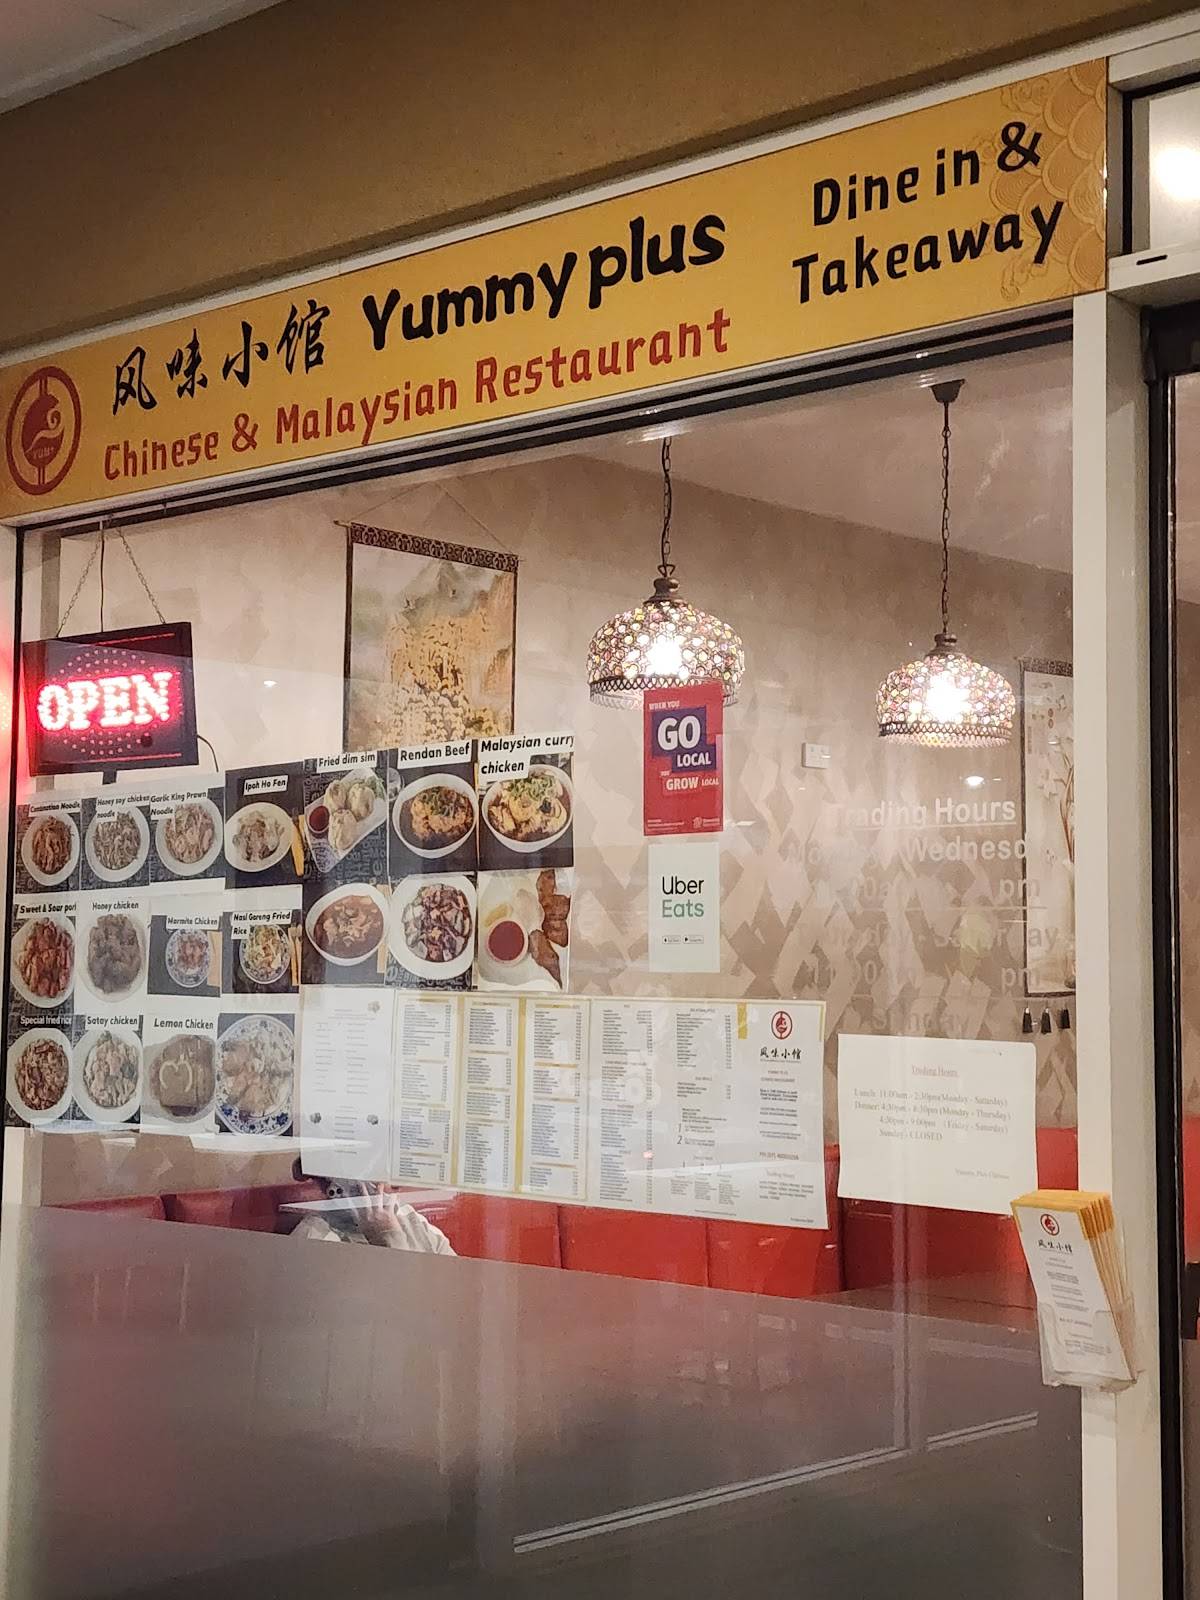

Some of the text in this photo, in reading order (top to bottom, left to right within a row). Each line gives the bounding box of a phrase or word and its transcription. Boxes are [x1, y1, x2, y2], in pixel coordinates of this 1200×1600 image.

[813, 121, 1042, 226] Dine in &
[792, 201, 1064, 304] Takeaway
[362, 214, 726, 350] Yummy plus
[113, 301, 331, 415] 风味小馆
[104, 308, 731, 481] Chinese & Malaysian Restaurant
[37, 671, 173, 731] OPEN
[657, 715, 701, 751] GO
[400, 742, 470, 761] Rendan Beef
[481, 736, 542, 753] Malaysian
[319, 751, 376, 768] Fried dim sim
[677, 752, 712, 767] LOCAL
[481, 760, 525, 775] chicken
[666, 777, 720, 790] GROW LOCAL
[150, 791, 207, 803] Garlic King Prawn
[150, 806, 174, 816] Noodle
[934, 797, 1017, 823] Hours
[662, 876, 704, 895] Uber
[20, 904, 41, 914] Sweet
[48, 903, 63, 913] Sour
[92, 900, 139, 912] Honey chicken
[661, 899, 704, 918] Eats
[194, 916, 218, 926] Chicken
[272, 911, 291, 920] Fried
[233, 926, 248, 934] Rice
[20, 1015, 45, 1026] Special
[87, 1016, 138, 1027] Satay chicken
[154, 1018, 214, 1030] Lemon Chicken
[676, 1135, 683, 1145] 2
[909, 1131, 943, 1141] CLOSED
